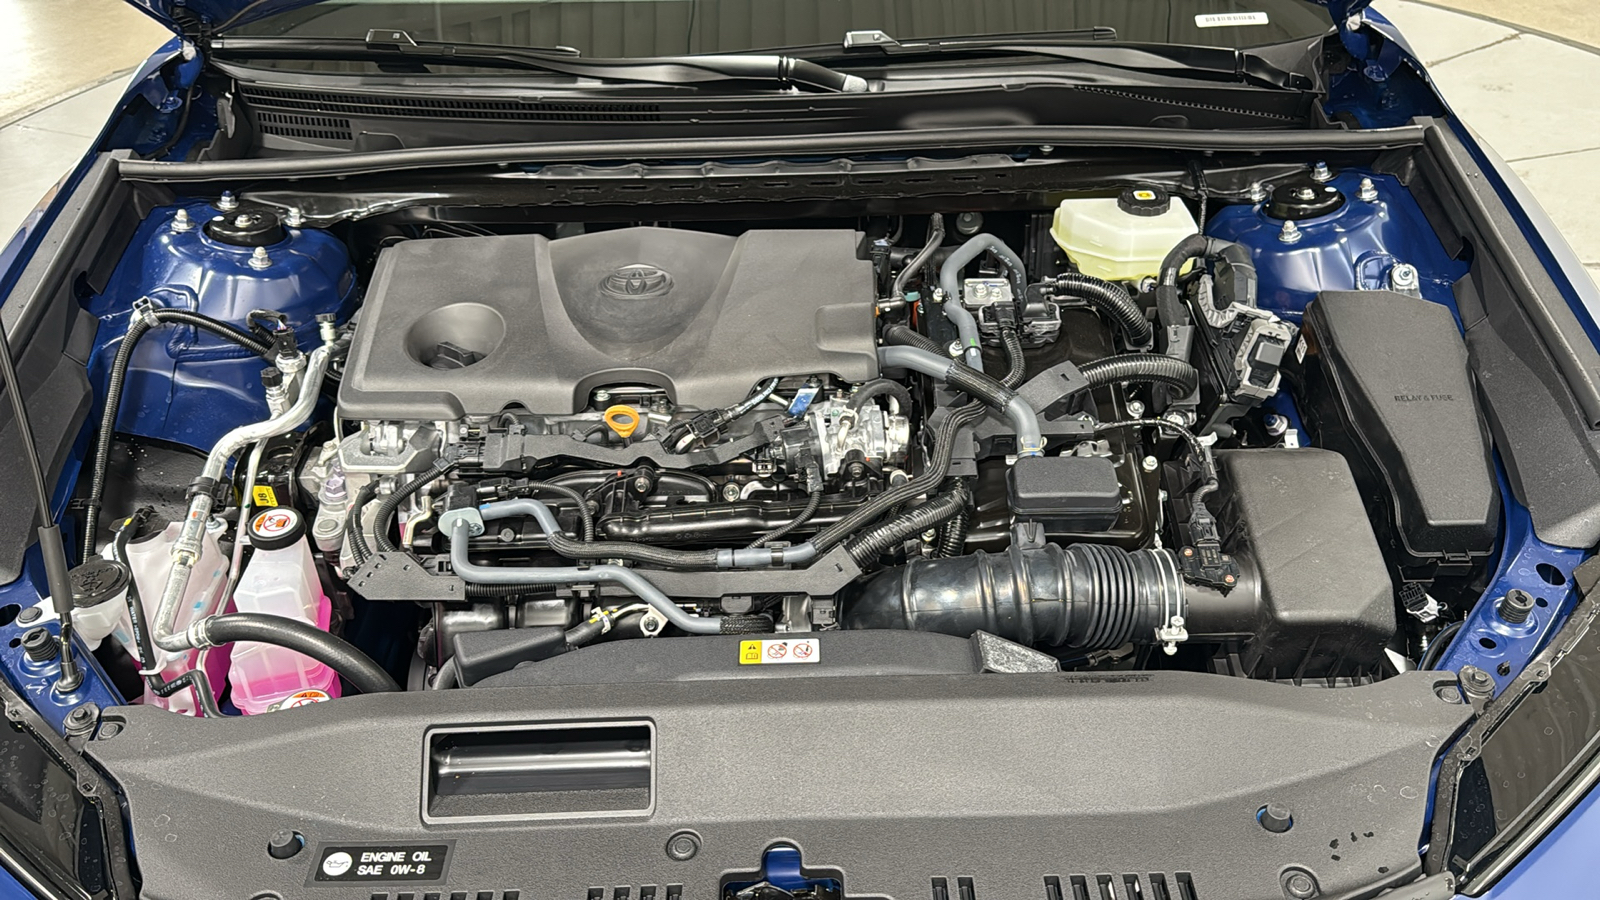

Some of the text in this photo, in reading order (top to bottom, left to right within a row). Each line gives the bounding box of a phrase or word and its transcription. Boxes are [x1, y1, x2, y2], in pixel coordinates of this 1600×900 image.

[1394, 394, 1422, 402] RELAY
[1430, 394, 1454, 402] FUSE
[360, 851, 432, 862] ENGINE OIL
[357, 864, 426, 876] SAE 0W-8
